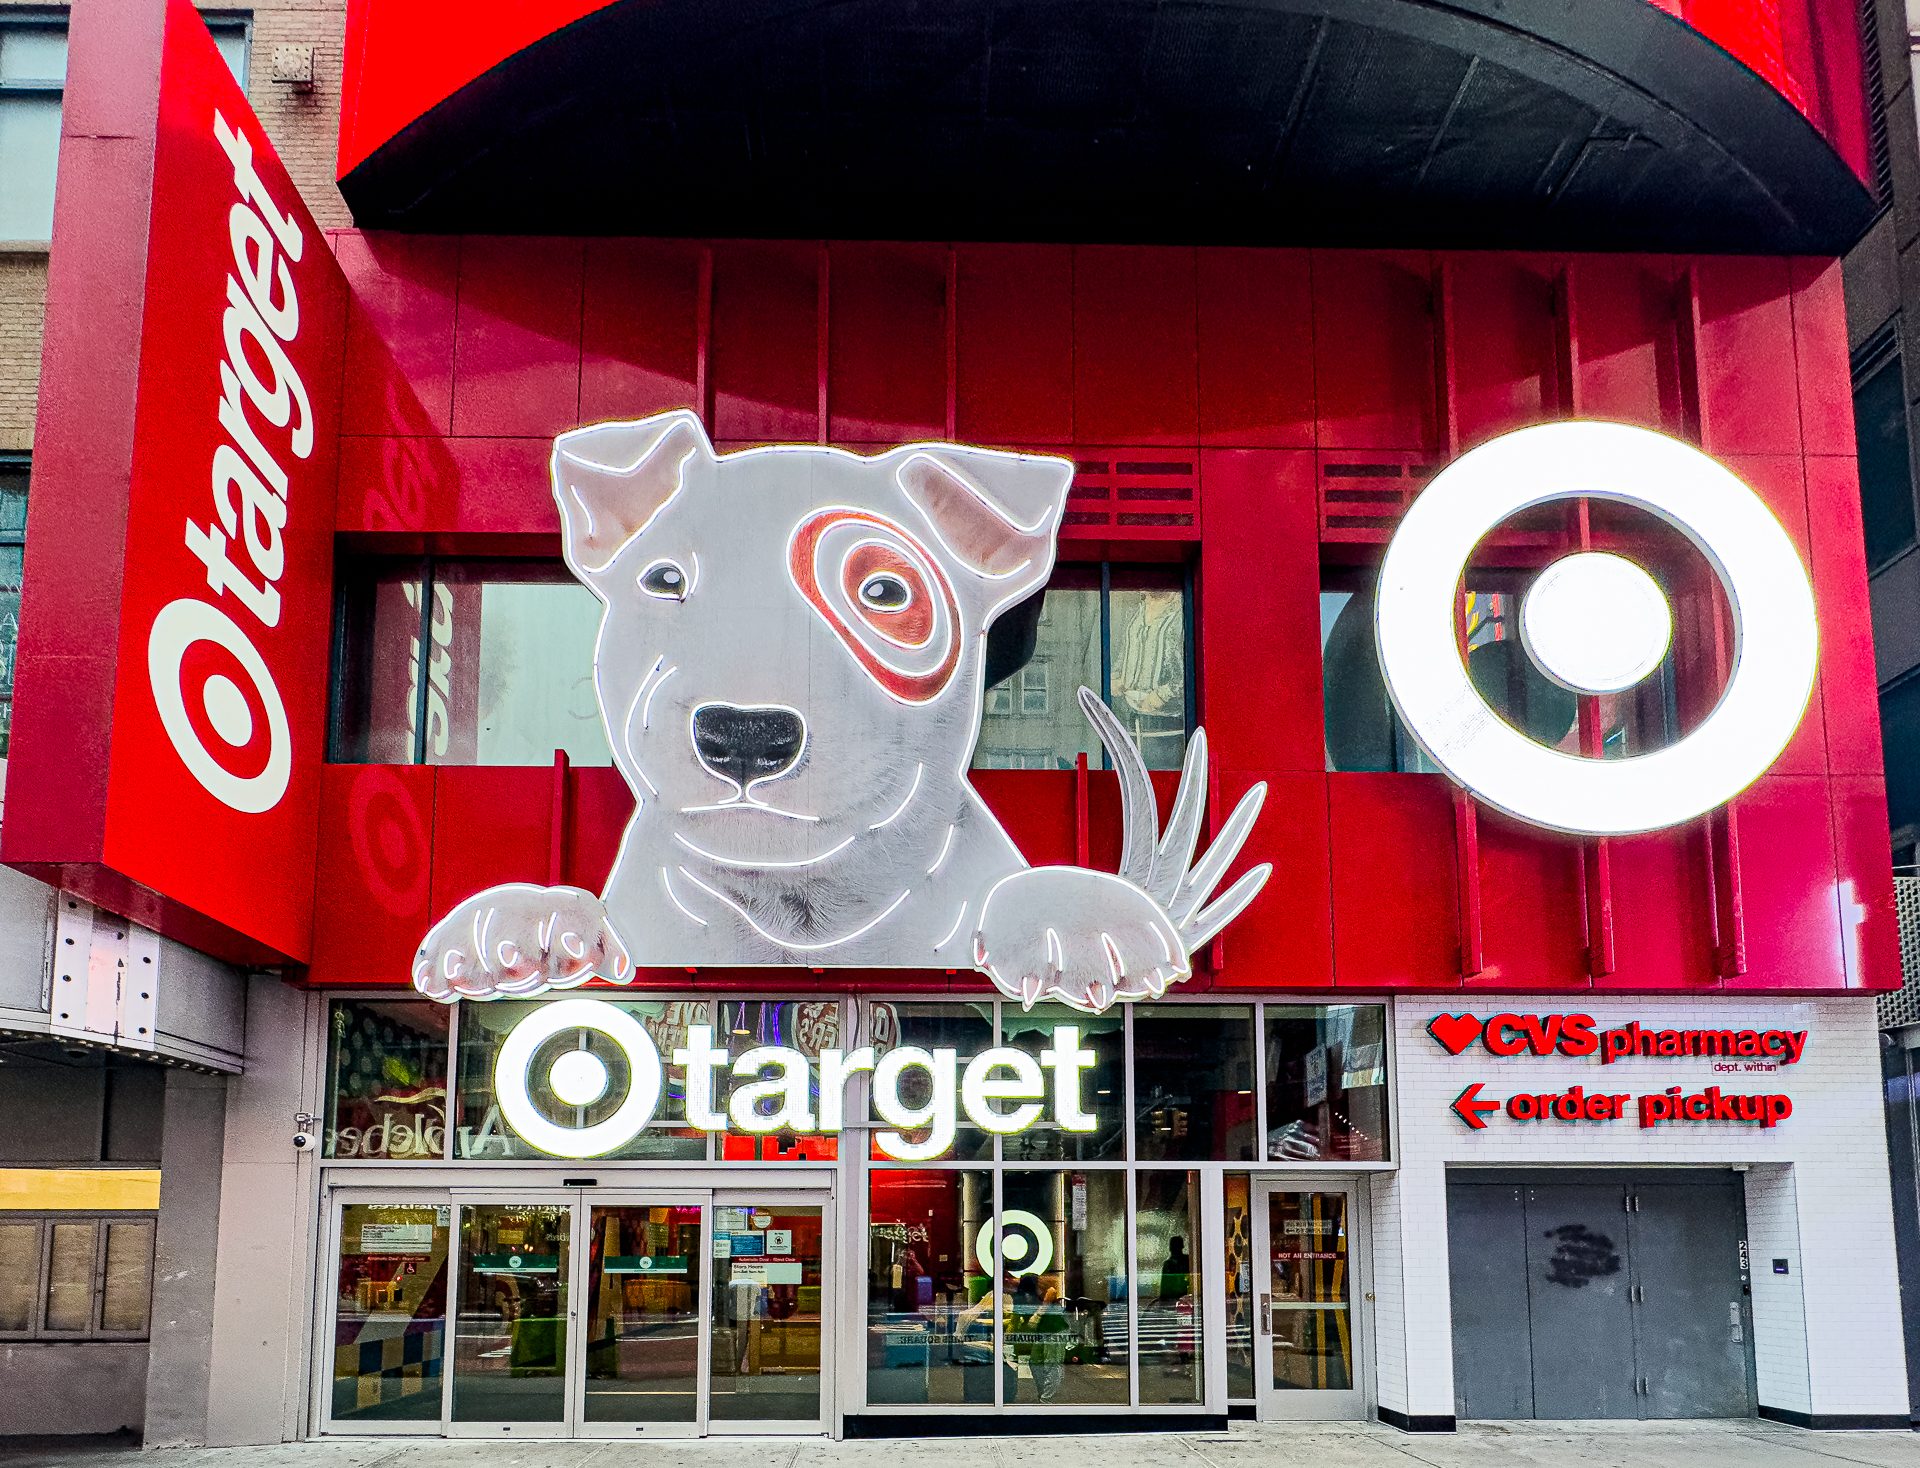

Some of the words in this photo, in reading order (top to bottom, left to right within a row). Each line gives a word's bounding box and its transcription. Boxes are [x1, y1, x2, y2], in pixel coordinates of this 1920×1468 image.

[185, 108, 313, 628] target
[1482, 1013, 1599, 1057] CVS
[1601, 1020, 1808, 1065] pharmacy
[1714, 1062, 1742, 1073] dept.
[1744, 1061, 1776, 1072] within
[672, 1024, 1098, 1161] target
[1506, 1085, 1631, 1121] order
[1638, 1085, 1793, 1128] pickup
[1740, 1241, 1748, 1269] 243
